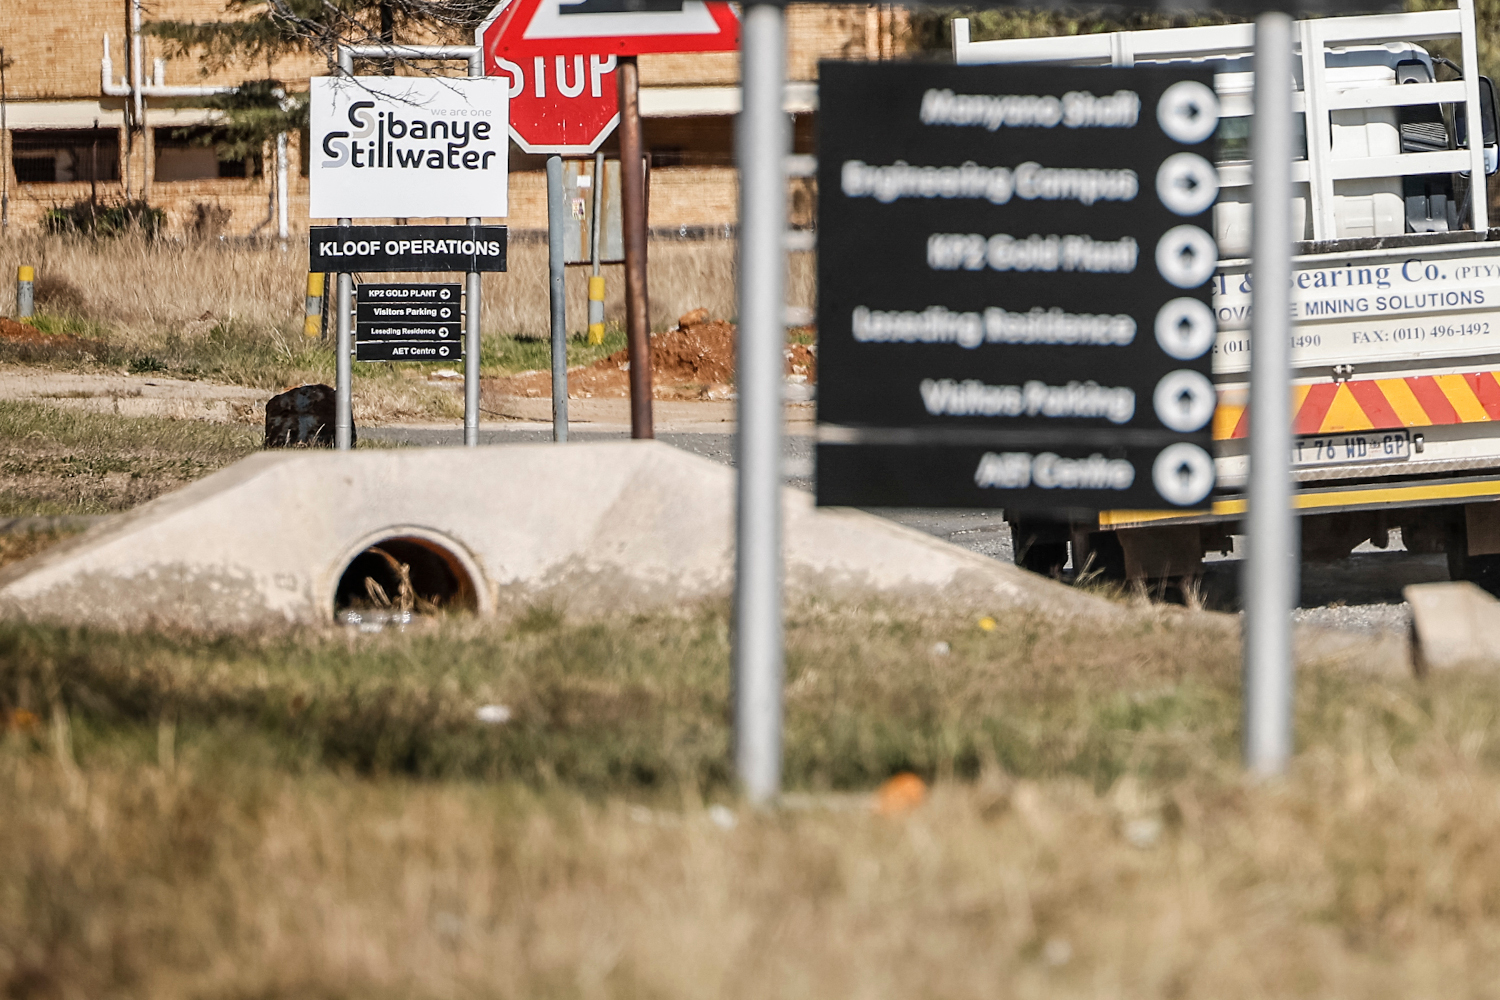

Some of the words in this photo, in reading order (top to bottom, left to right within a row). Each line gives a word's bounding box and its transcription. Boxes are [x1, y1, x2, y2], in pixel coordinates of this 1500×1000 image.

[430, 108, 447, 117] we
[449, 109, 468, 117] are
[470, 108, 492, 117] one
[348, 101, 491, 149] Sibanye
[321, 131, 497, 170] Stillwater
[319, 241, 381, 257] KLOOF
[384, 239, 501, 256] OPERATIONS
[1289, 262, 1392, 290] earing
[1401, 258, 1448, 285] Co.
[368, 289, 385, 298] KP2
[385, 289, 409, 298] GOLD
[410, 289, 438, 298] PLANT
[1305, 296, 1370, 317] MINING
[1376, 289, 1487, 311] SOLUTIONS
[373, 307, 405, 316] Visitors
[405, 307, 438, 317] Parking
[370, 327, 401, 336] Leseding
[401, 327, 436, 335] Residence
[1352, 329, 1389, 345] FAX:
[1391, 326, 1426, 343] (011)
[1429, 321, 1491, 339] 496-1492
[392, 347, 409, 356] AET
[410, 347, 436, 355] Centre
[1314, 440, 1336, 461] 76
[1344, 437, 1367, 459] WD
[1383, 434, 1405, 455] GP
